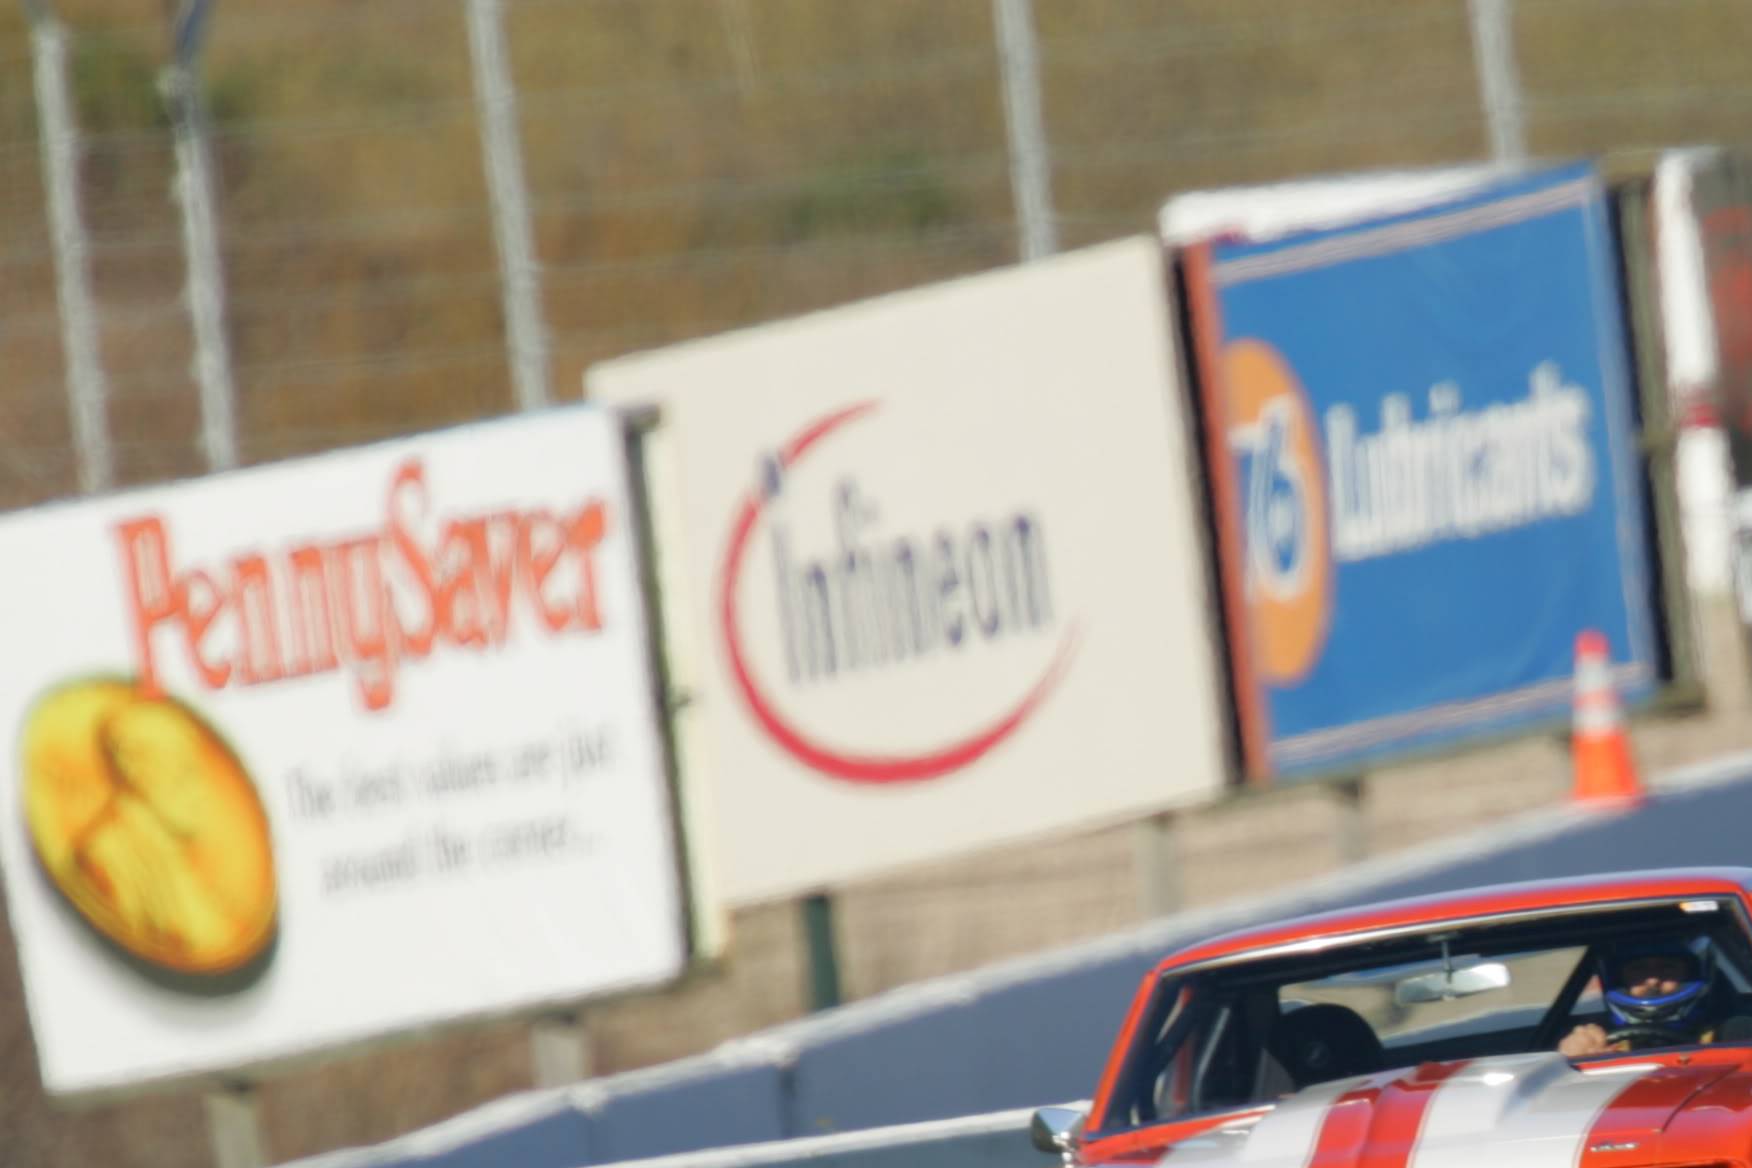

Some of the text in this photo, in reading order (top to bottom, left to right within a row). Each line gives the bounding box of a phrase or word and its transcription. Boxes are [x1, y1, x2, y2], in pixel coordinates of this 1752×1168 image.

[112, 457, 608, 710] PennySaver
[762, 450, 1055, 685] Infineon
[1228, 360, 1595, 600] 76 Lubricants
